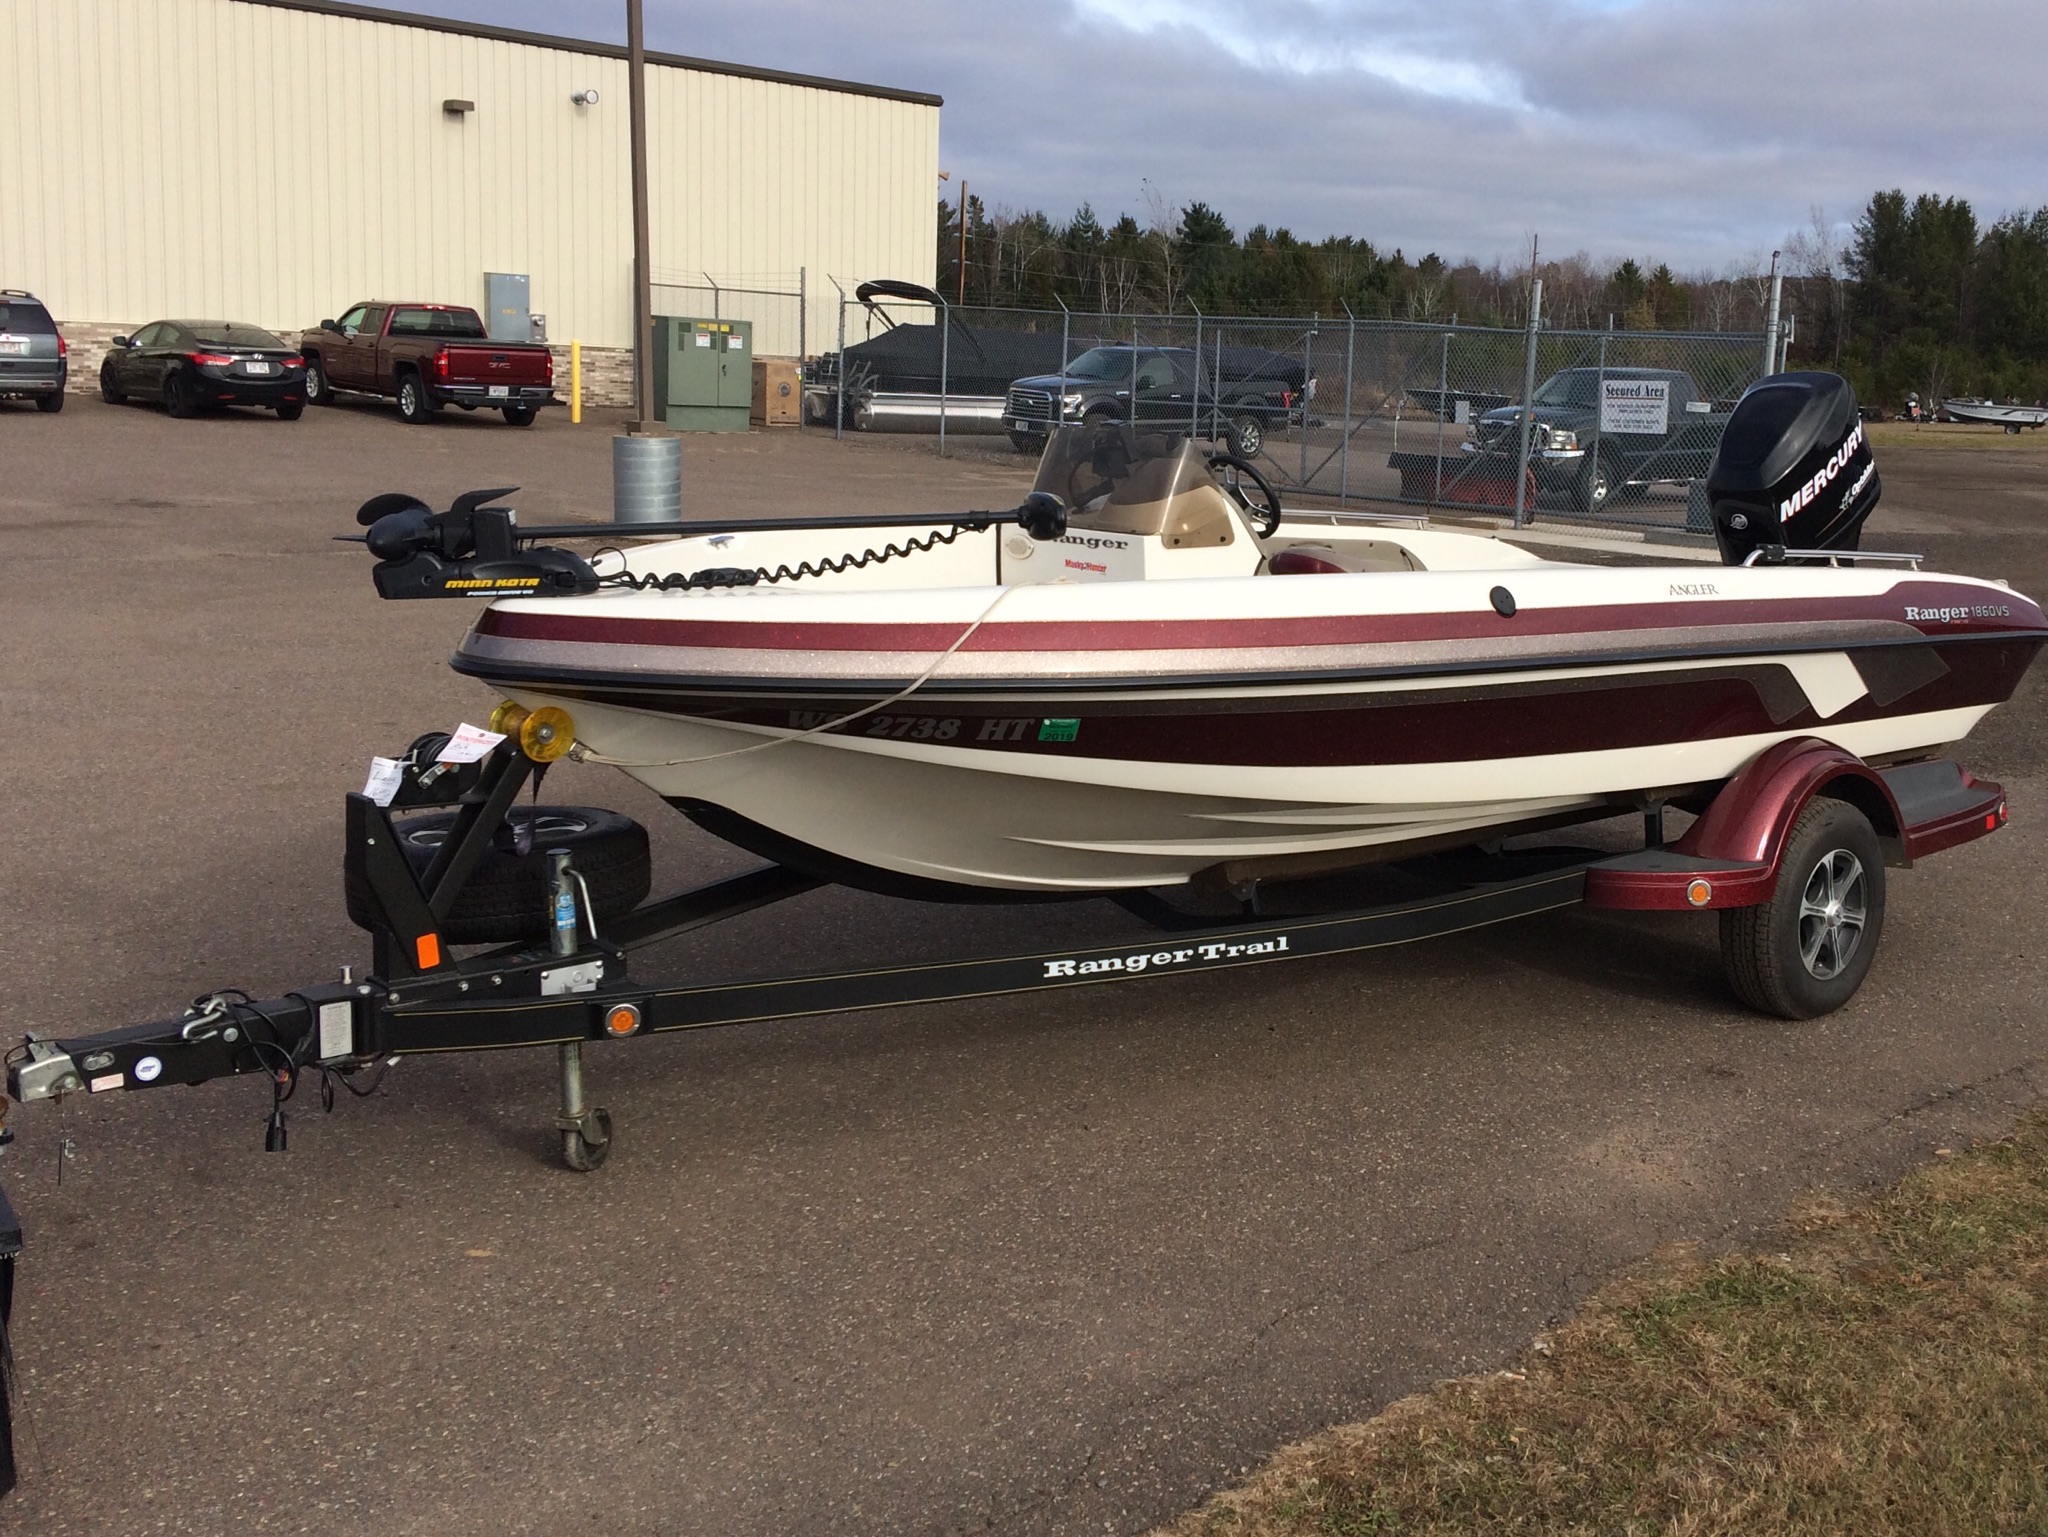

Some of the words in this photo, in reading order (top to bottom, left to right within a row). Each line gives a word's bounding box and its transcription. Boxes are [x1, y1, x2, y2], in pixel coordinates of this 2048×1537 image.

[1606, 384, 1640, 397] Secured
[1645, 385, 1664, 397] Area
[1780, 419, 1862, 523] MERCURY
[1053, 535, 1128, 550] anger
[495, 578, 540, 587] KOTA
[1669, 584, 1719, 596] ANGLER
[1904, 606, 1969, 623] Ranger
[1971, 605, 2010, 617] 1860VS
[866, 716, 961, 740] 2738
[975, 718, 1035, 741] HT
[1044, 733, 1074, 741] 2019
[1043, 948, 1194, 978] Ranger
[1198, 936, 1289, 960] Trail
